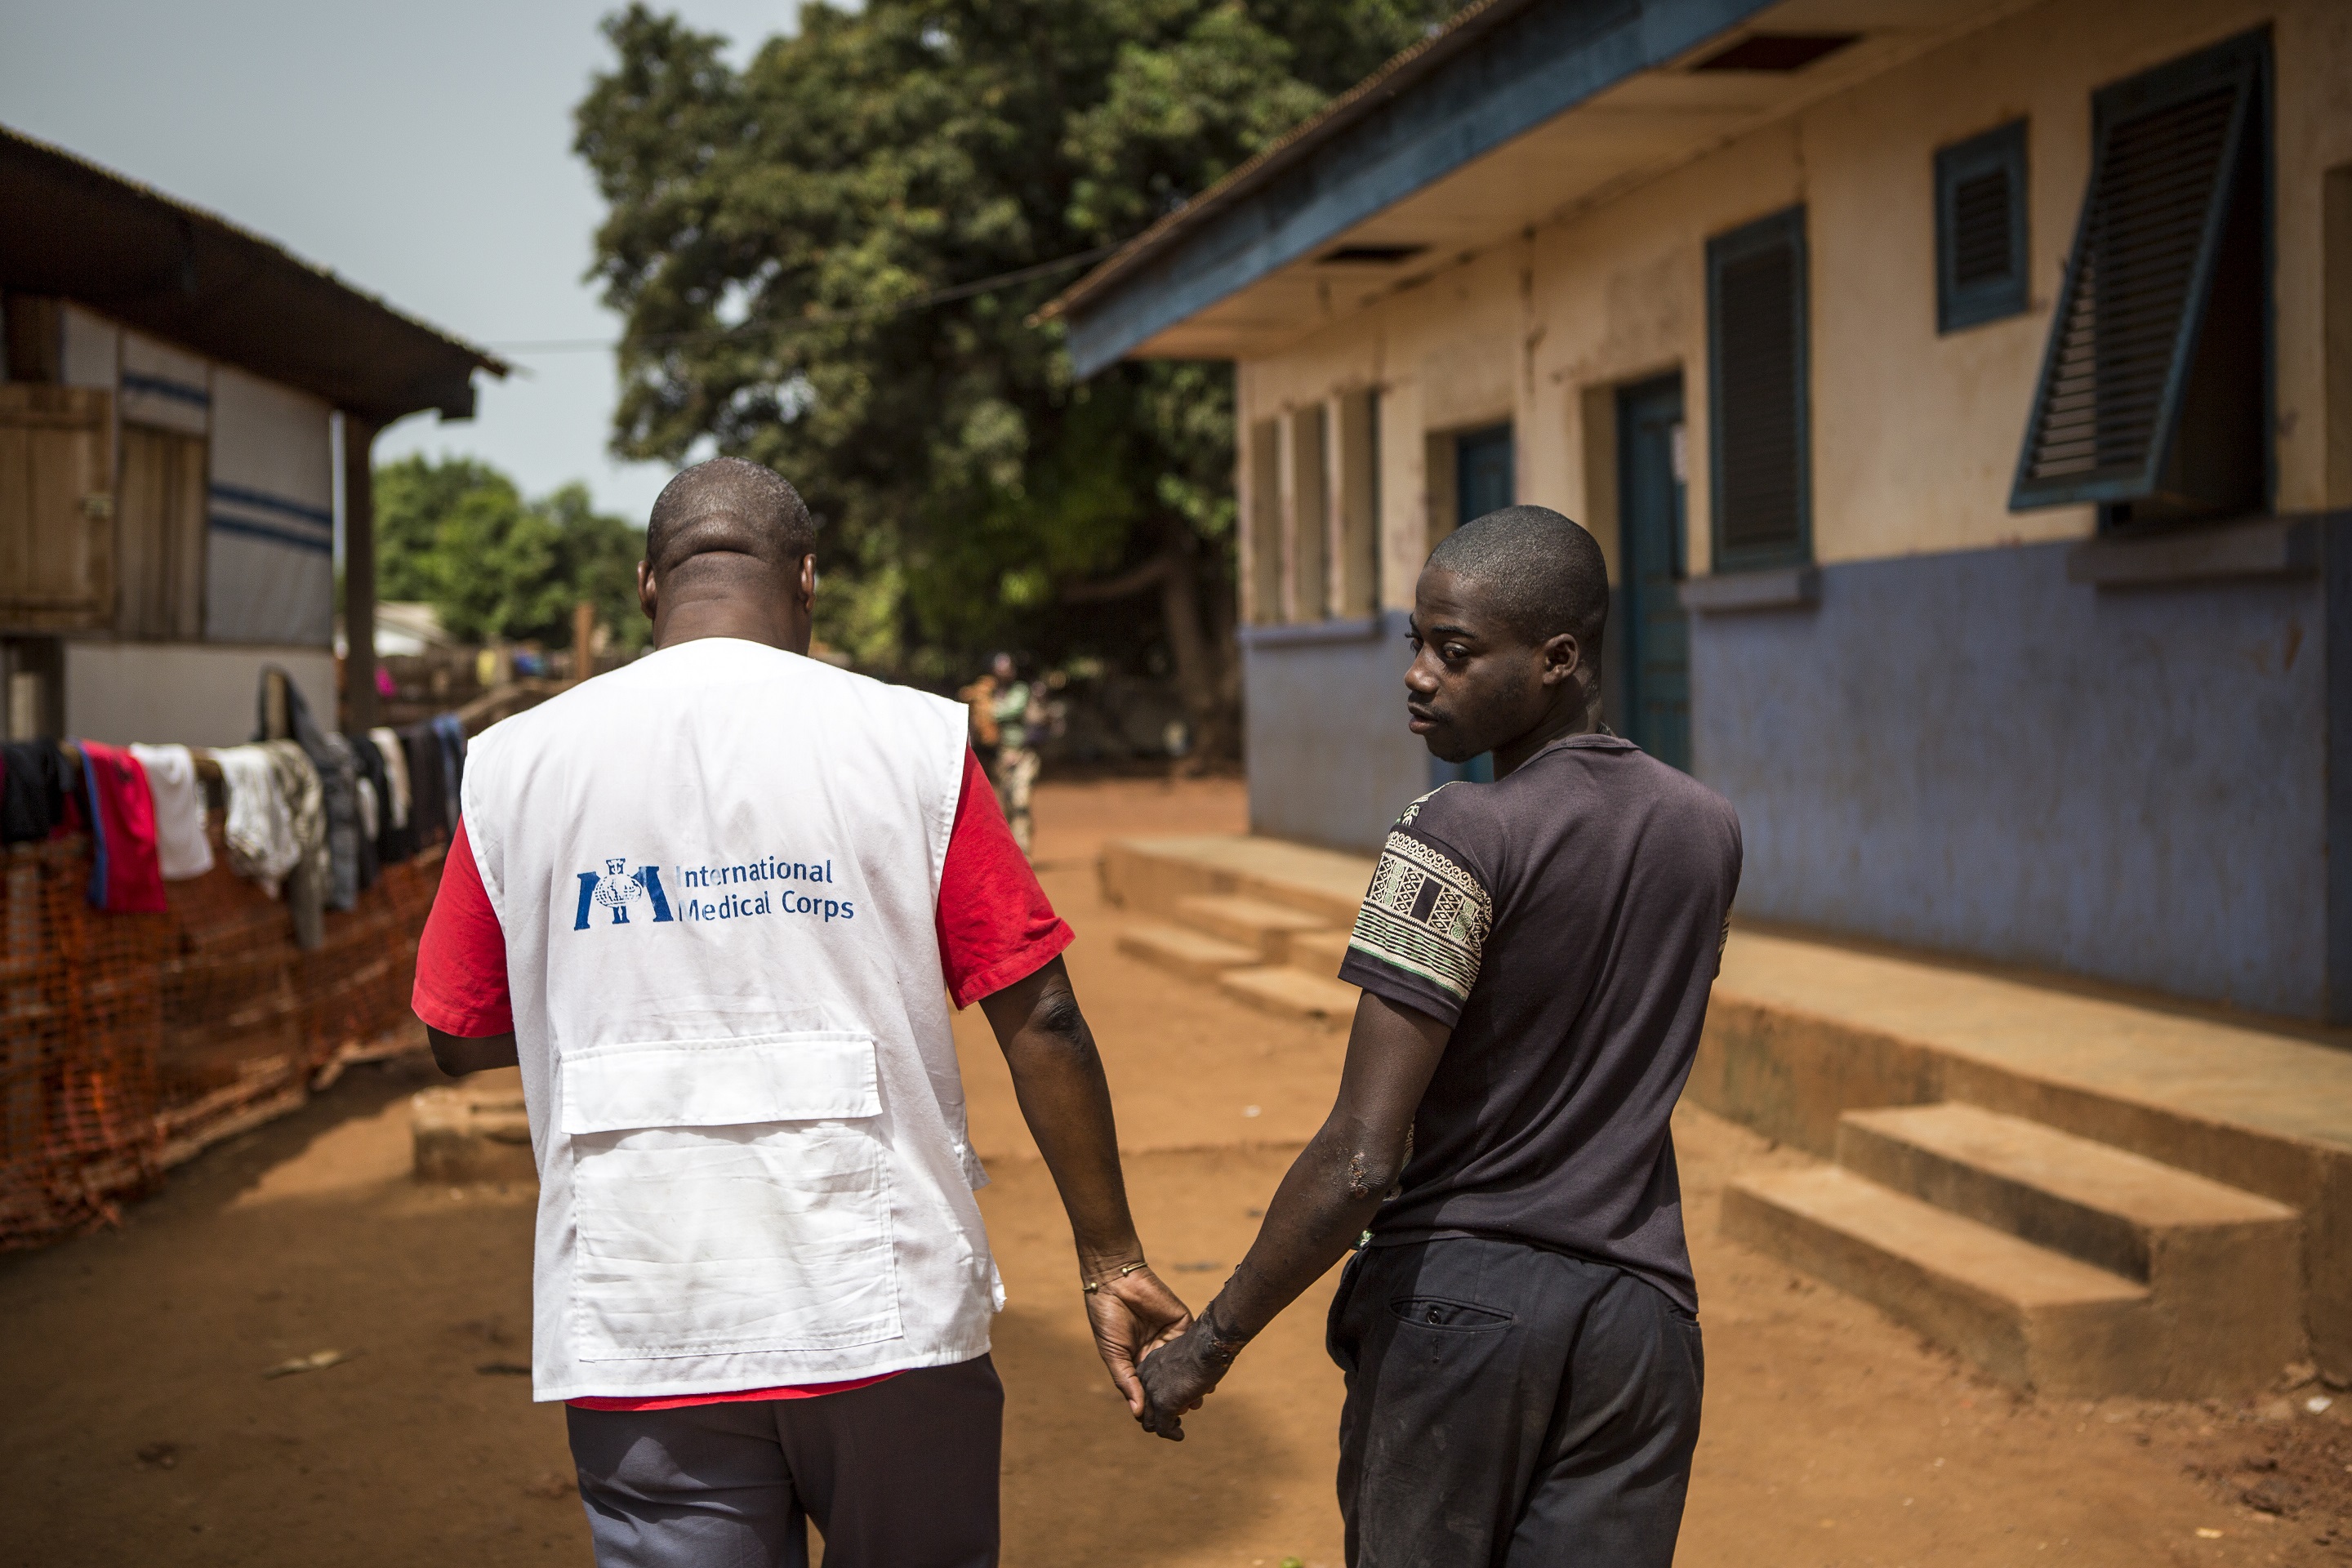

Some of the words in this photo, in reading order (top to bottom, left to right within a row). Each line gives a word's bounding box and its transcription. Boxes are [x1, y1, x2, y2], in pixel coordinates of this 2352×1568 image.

[675, 855, 833, 888] International
[678, 890, 772, 922] Medical
[782, 889, 854, 923] Corps
